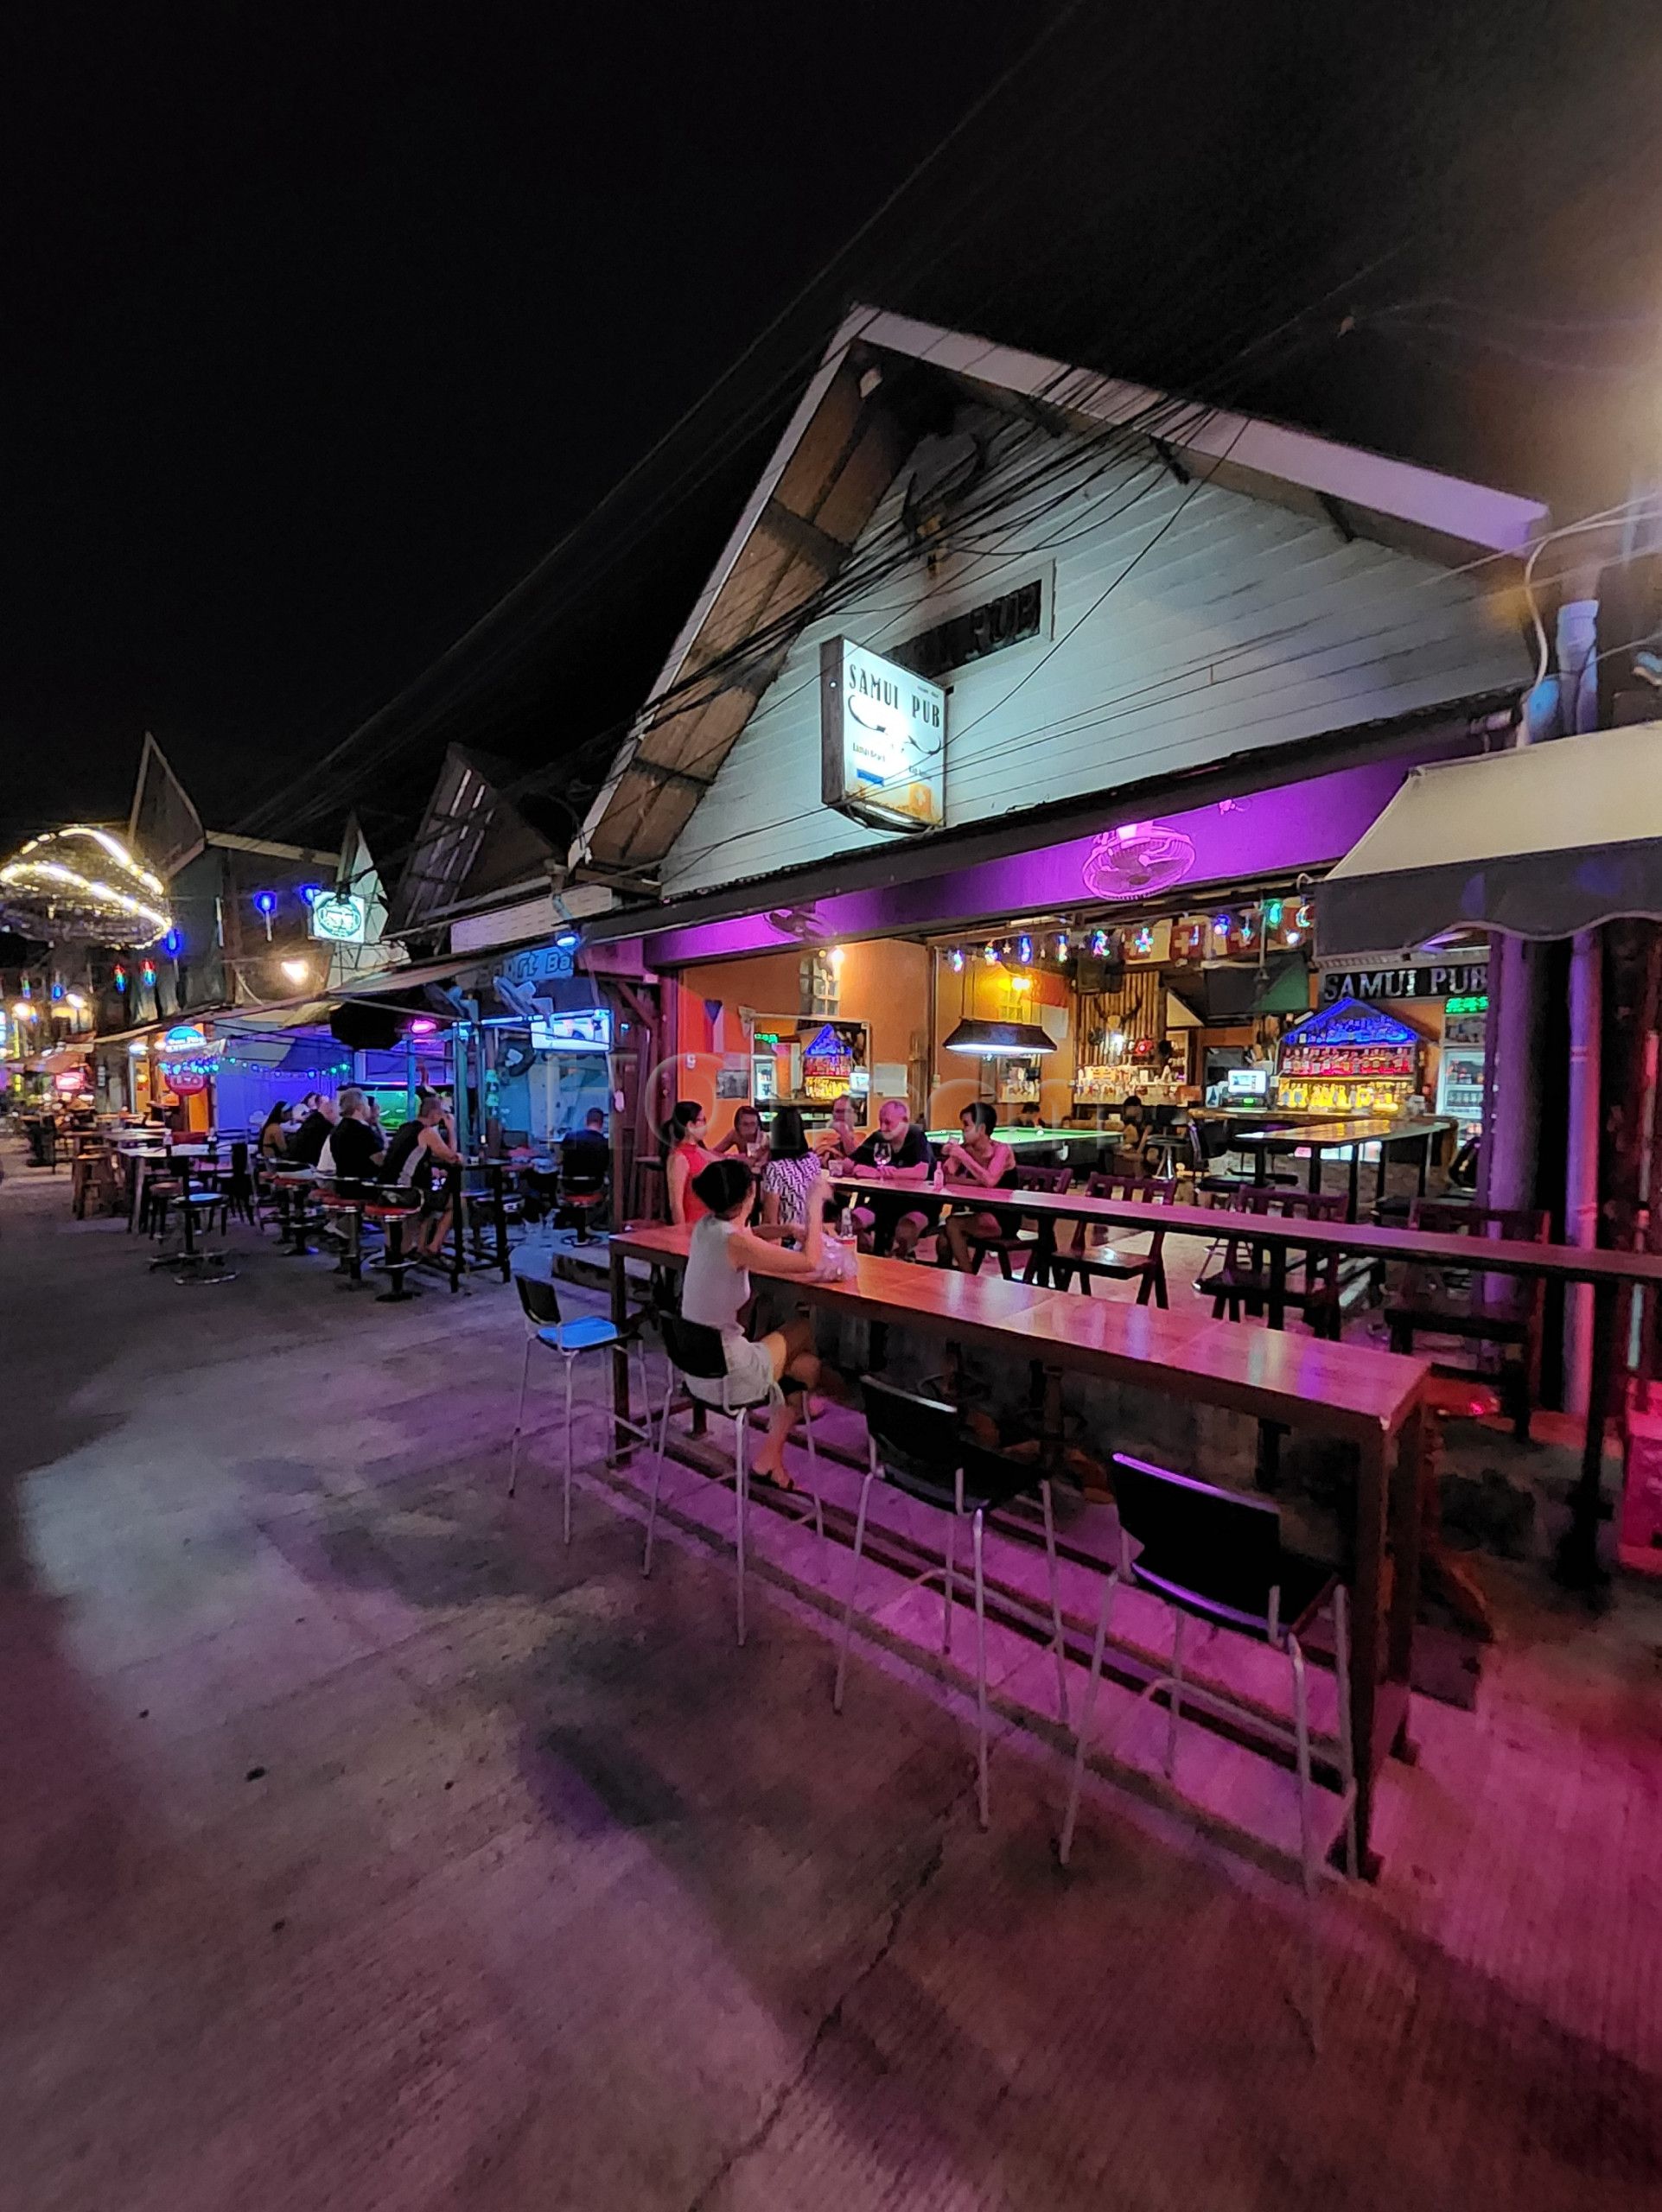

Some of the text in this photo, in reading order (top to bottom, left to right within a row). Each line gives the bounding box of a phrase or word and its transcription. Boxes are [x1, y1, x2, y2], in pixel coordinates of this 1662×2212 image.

[849, 664, 939, 728] SAMUI PUB
[545, 951, 574, 974] Ba
[1325, 964, 1487, 1003] SAMUI PUB
